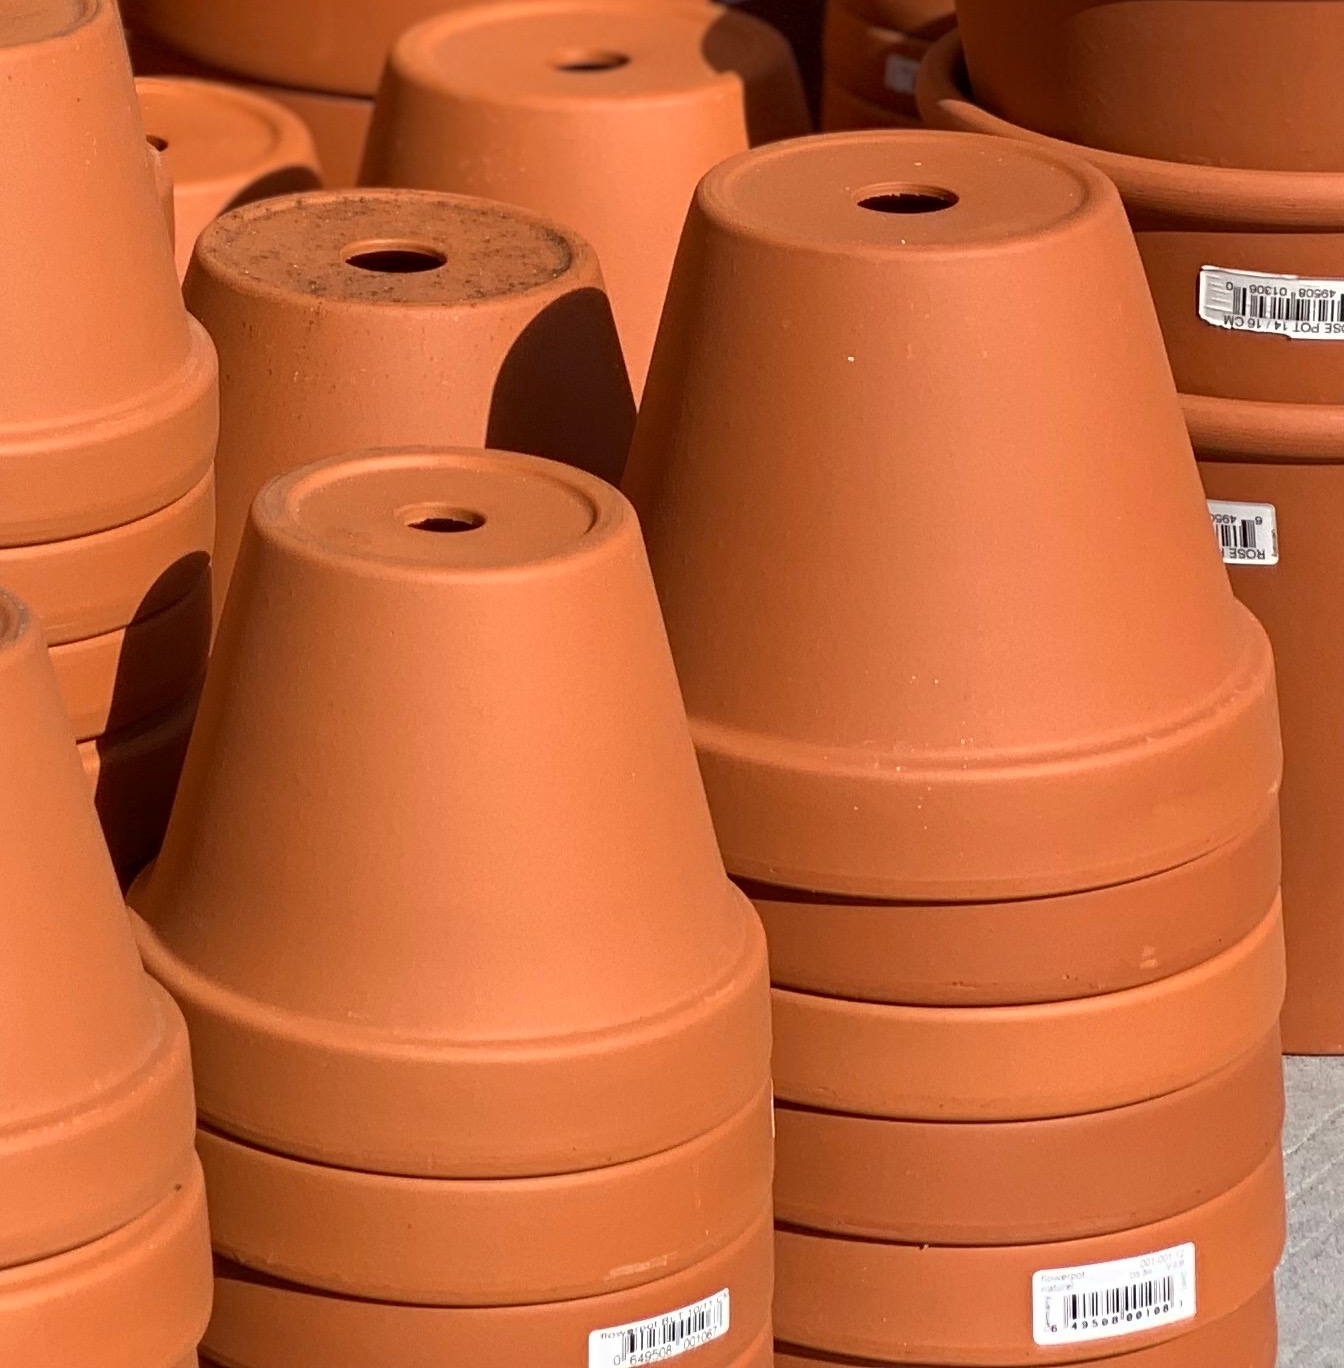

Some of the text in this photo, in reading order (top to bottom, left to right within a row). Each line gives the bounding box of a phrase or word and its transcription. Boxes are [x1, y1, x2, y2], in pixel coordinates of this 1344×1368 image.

[1249, 284, 1288, 297] 01306
[1298, 288, 1336, 298] 49508
[1223, 314, 1245, 327] CM
[1247, 317, 1262, 330] 16
[1274, 321, 1288, 332] 14
[1293, 322, 1320, 333] POT
[1229, 547, 1266, 560] ROSE
[1072, 1316, 1119, 1330] 49508
[1126, 1303, 1169, 1322] 00108
[613, 1325, 718, 1366] 0 649508 001067
